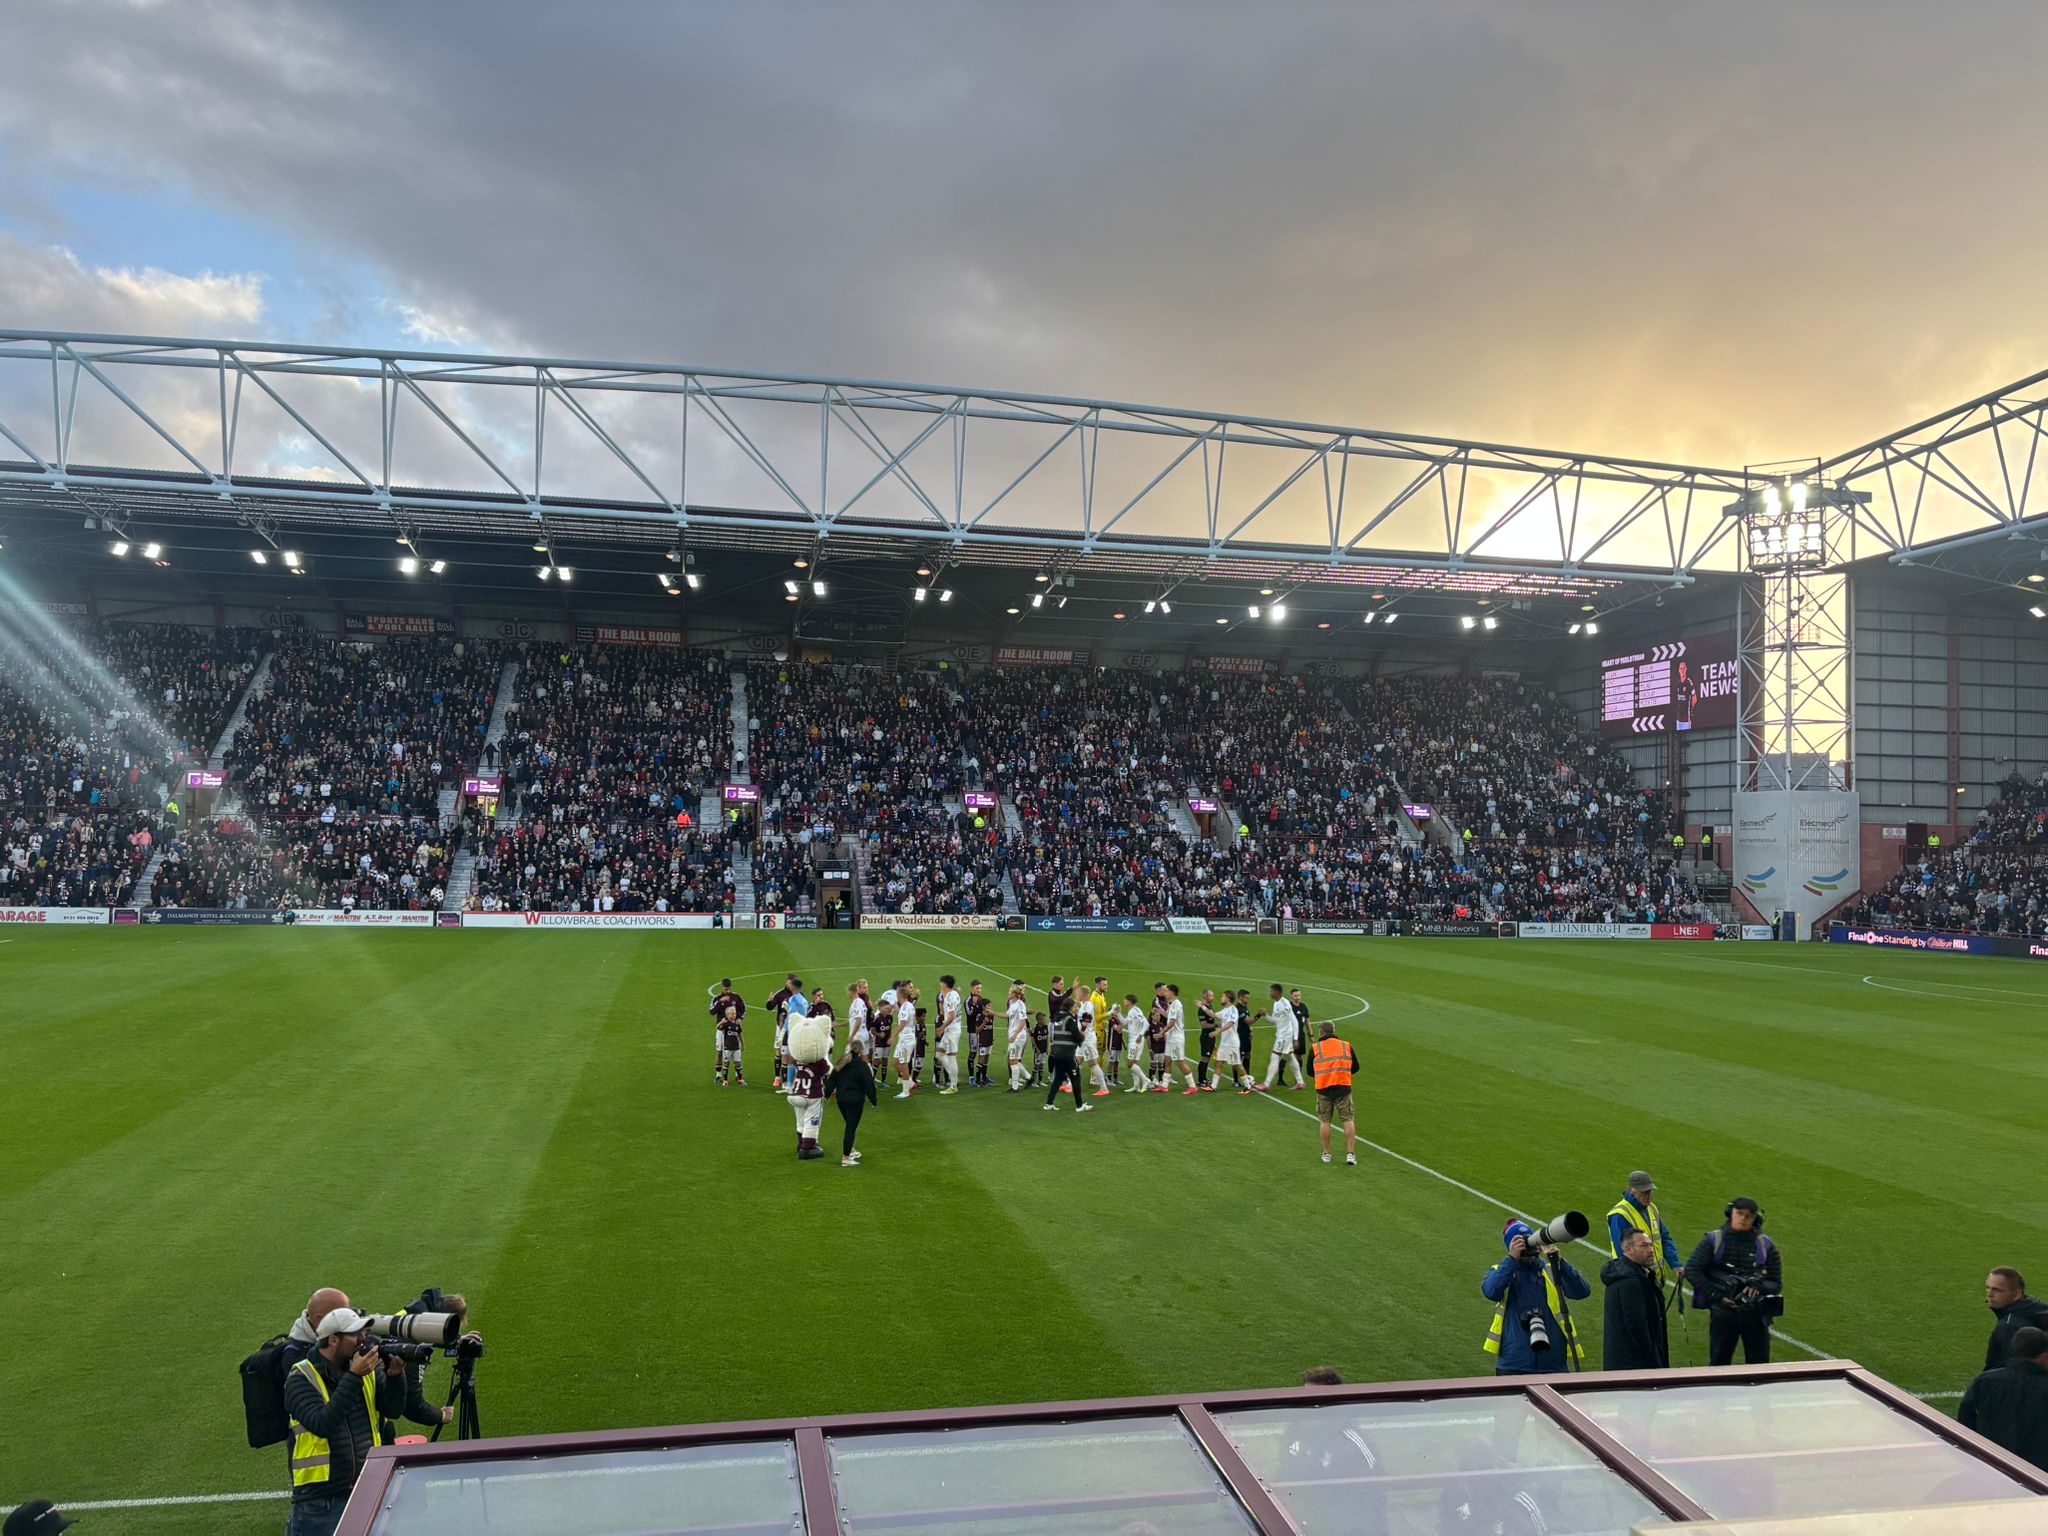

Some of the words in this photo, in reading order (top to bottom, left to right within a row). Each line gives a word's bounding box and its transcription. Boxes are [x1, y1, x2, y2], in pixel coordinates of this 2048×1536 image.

[598, 628, 618, 640] THE
[620, 629, 646, 641] BALL
[650, 630, 680, 642] ROOM
[998, 648, 1017, 658] THE
[1018, 649, 1041, 660] BALL
[1043, 650, 1072, 660] ROOM
[1701, 660, 1738, 680] TEAM
[1700, 678, 1738, 698] NEWS
[1800, 820, 1836, 828] Elecmech
[525, 912, 600, 925] WILLOWBRAE
[603, 916, 675, 925] COACHWORKS
[862, 916, 893, 924] Purdie
[895, 916, 946, 924] Worldwide
[1551, 924, 1621, 934] EDINBURGH
[1674, 926, 1700, 936] LNER
[1918, 938, 1926, 948] by
[1953, 939, 1968, 950] HILL
